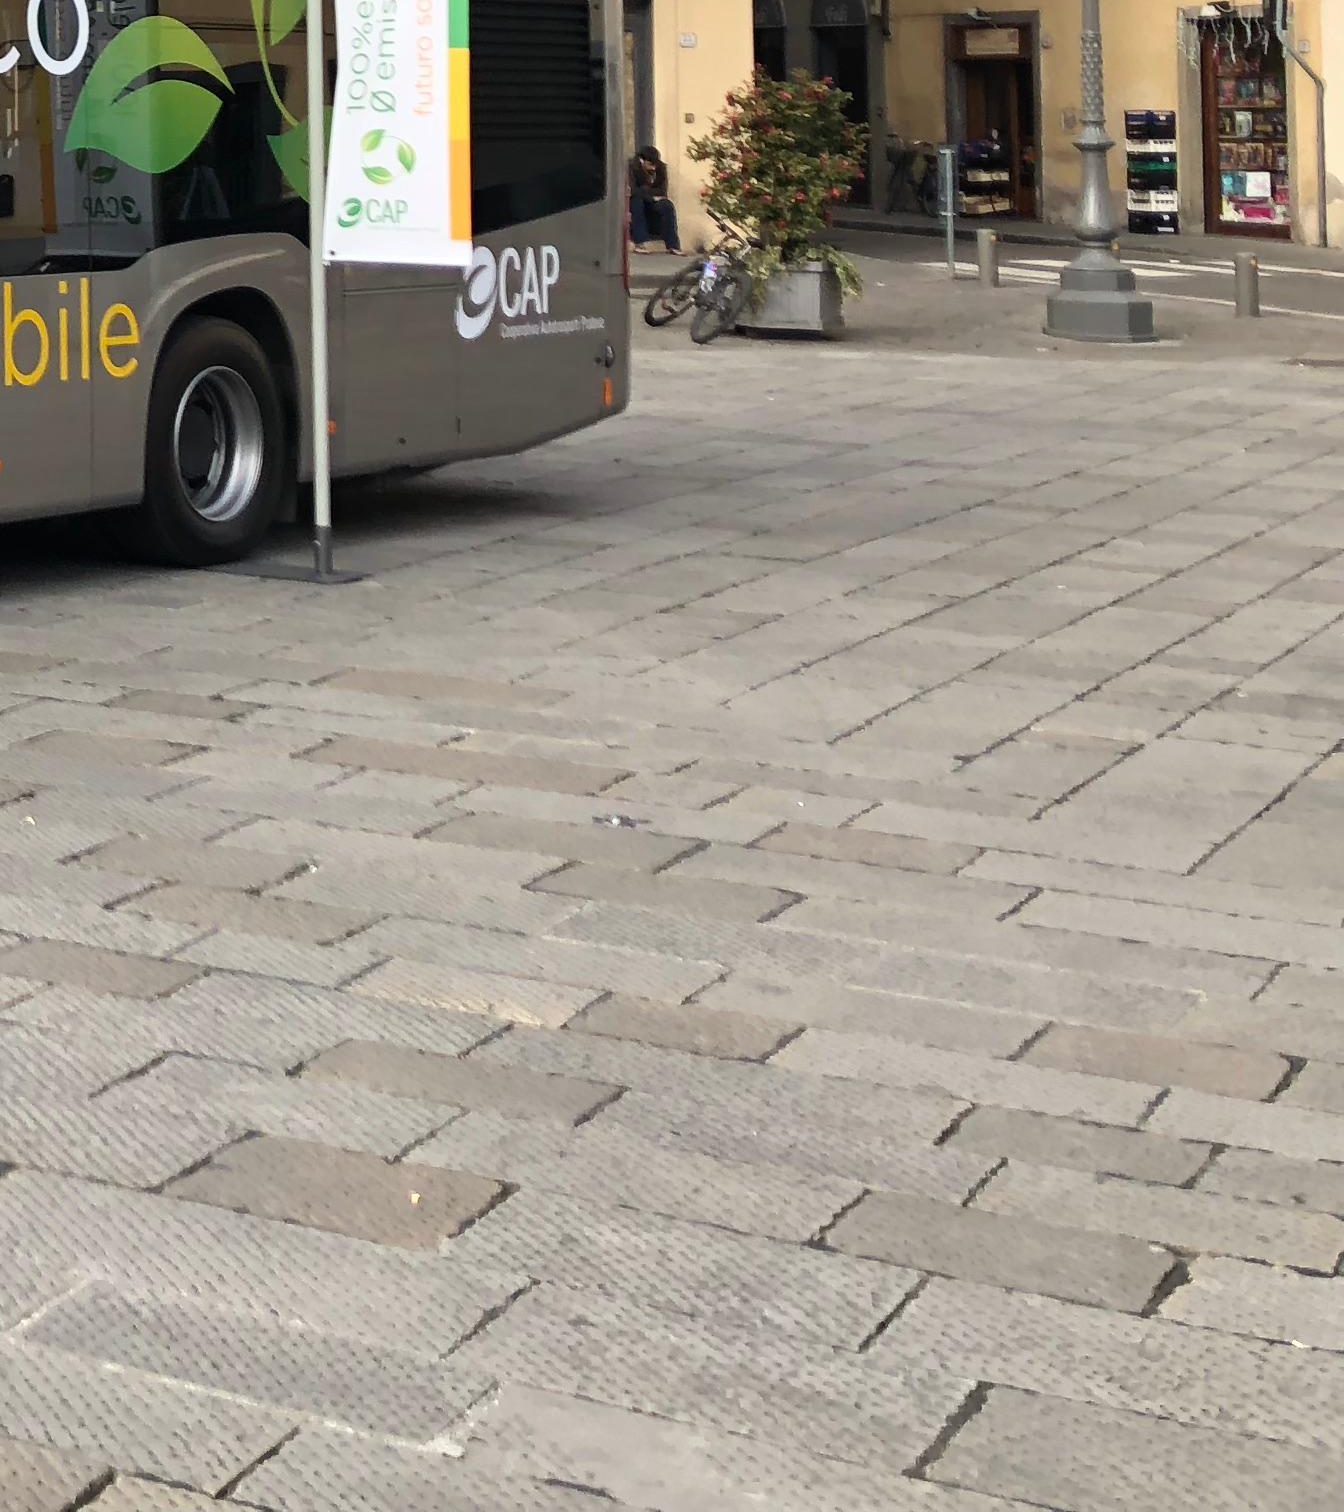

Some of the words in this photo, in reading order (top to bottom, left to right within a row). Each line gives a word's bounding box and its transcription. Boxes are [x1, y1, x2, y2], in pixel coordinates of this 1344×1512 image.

[413, 35, 433, 117] futuro
[365, 199, 409, 223] CAP
[499, 244, 561, 318] CAP
